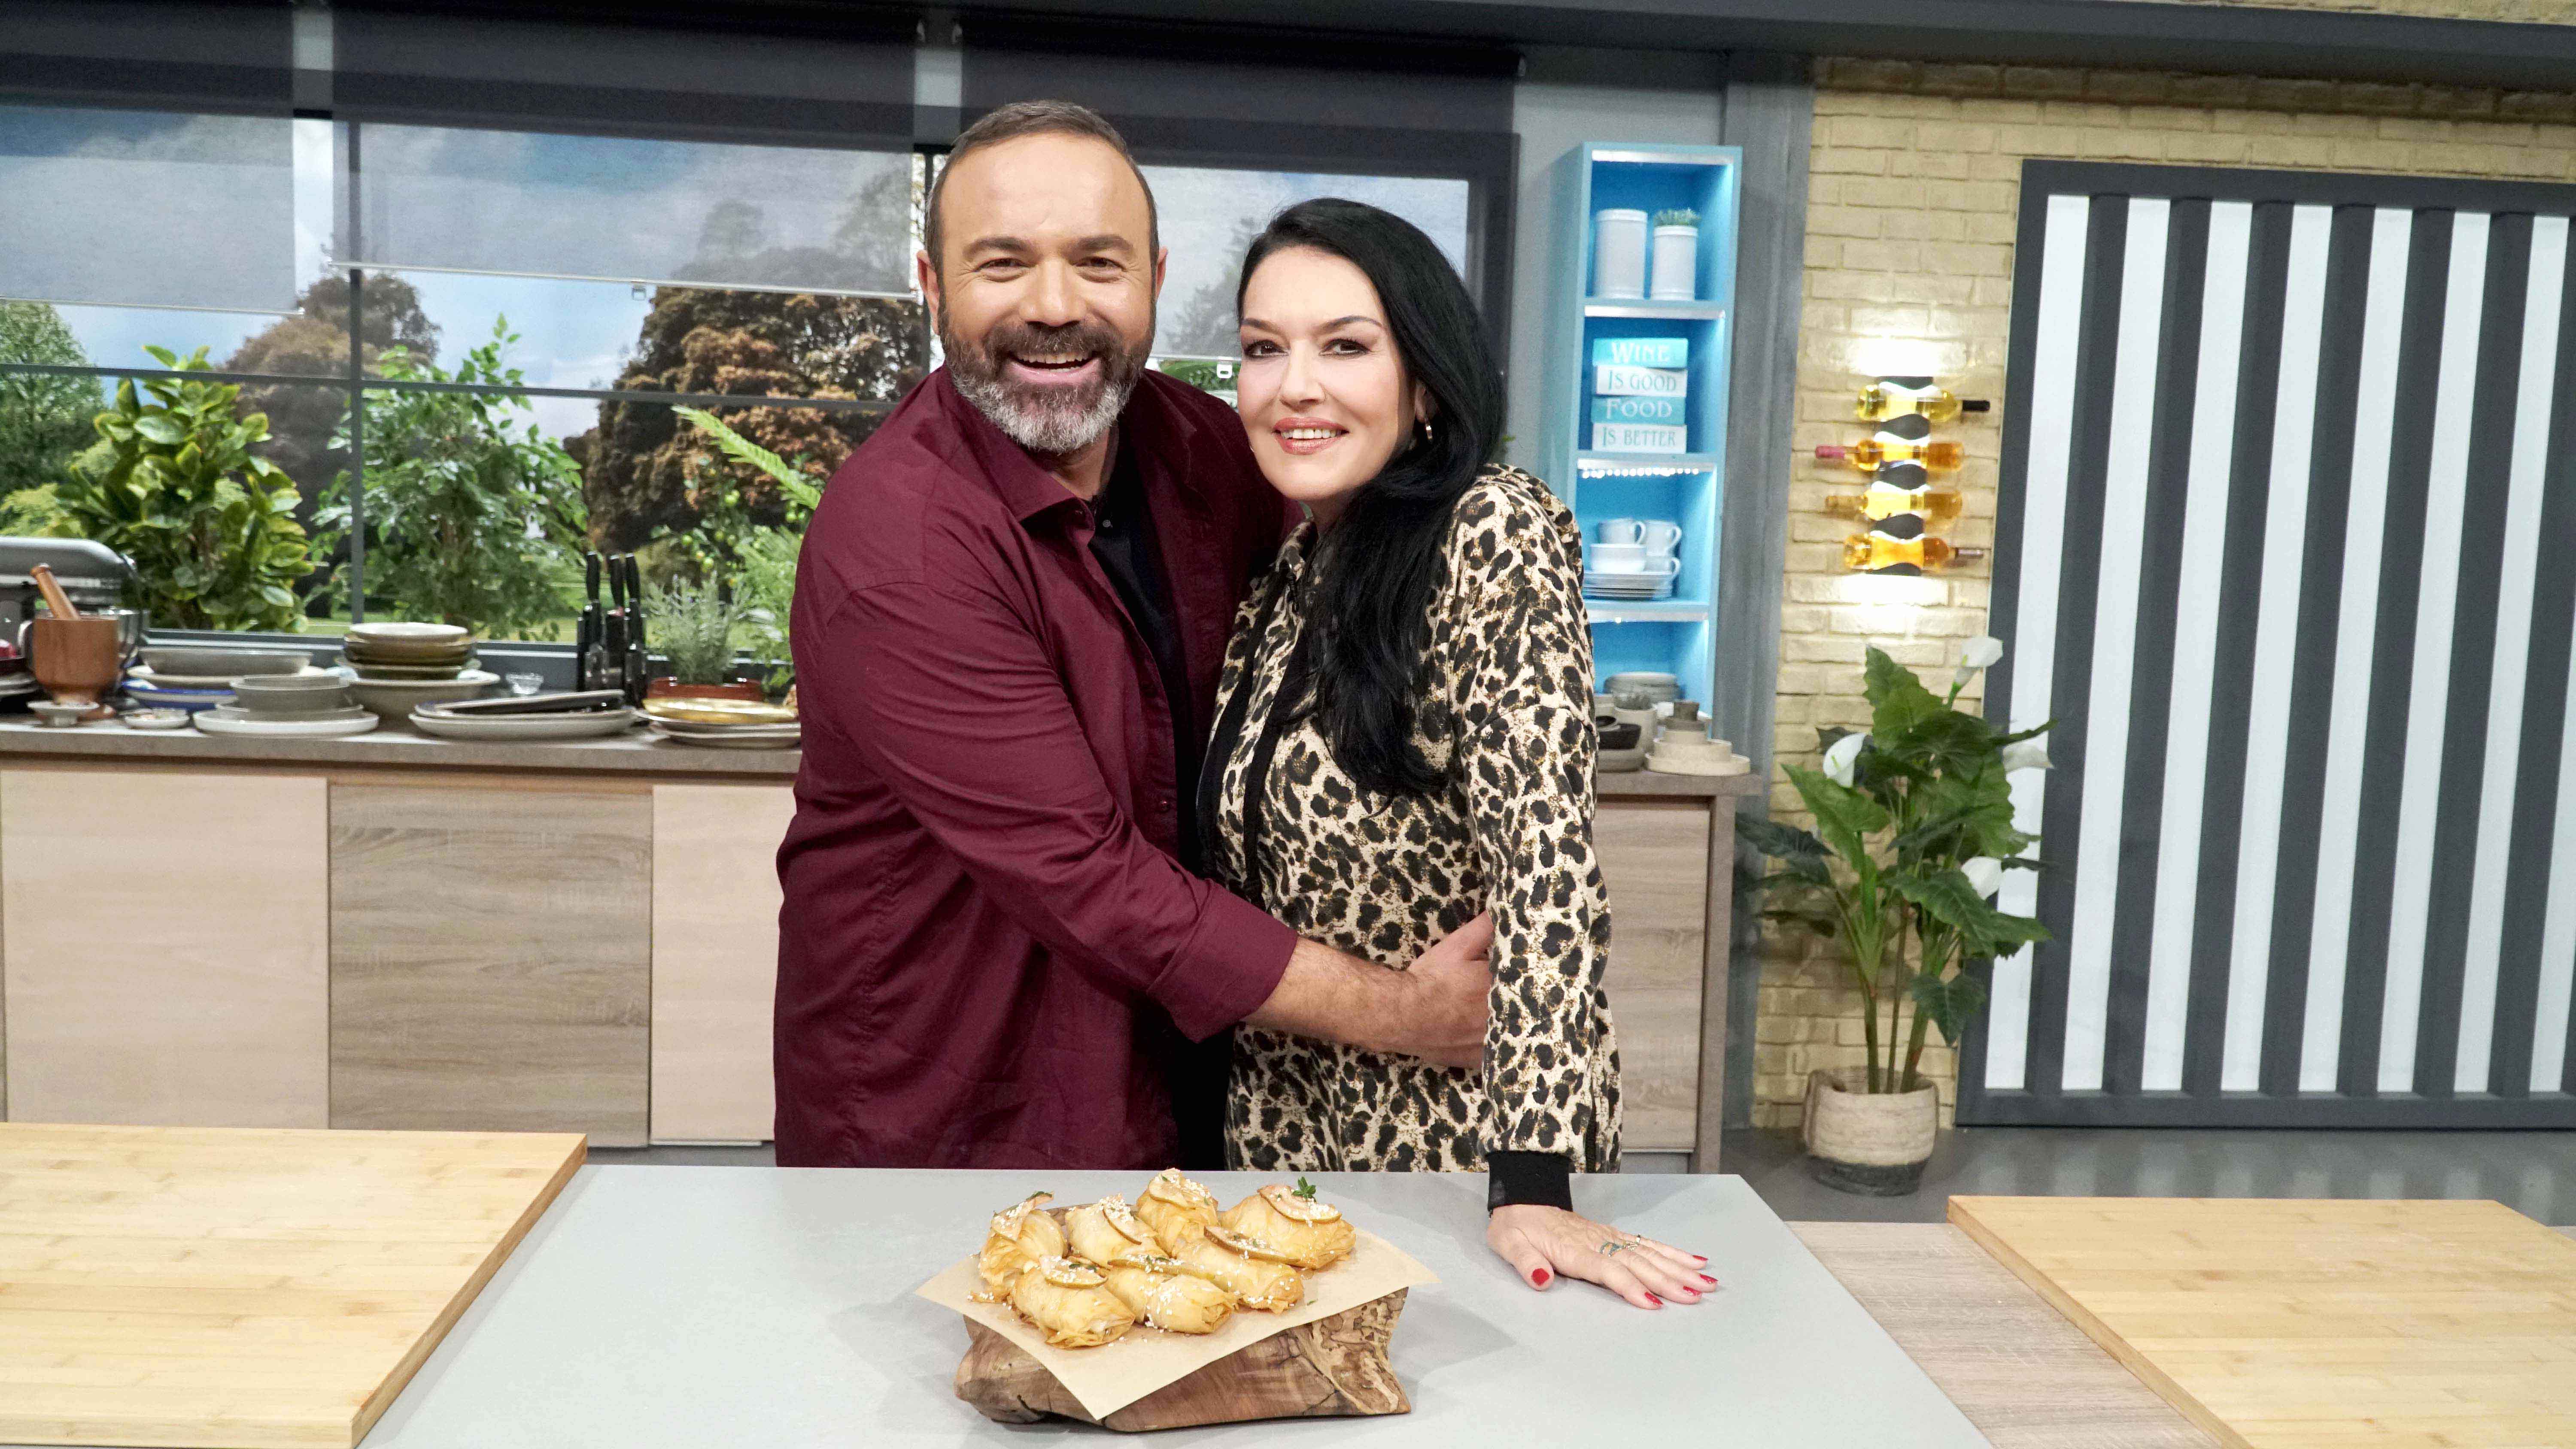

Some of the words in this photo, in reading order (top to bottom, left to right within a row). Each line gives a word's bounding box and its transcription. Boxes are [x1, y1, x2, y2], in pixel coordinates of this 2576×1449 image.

[1611, 342, 1671, 363] WINE
[1608, 370, 1624, 390] IS
[1630, 373, 1677, 391] GOOD
[1606, 399, 1673, 419] FOOD
[1602, 427, 1616, 446] IS
[1624, 430, 1676, 446] BETTER
